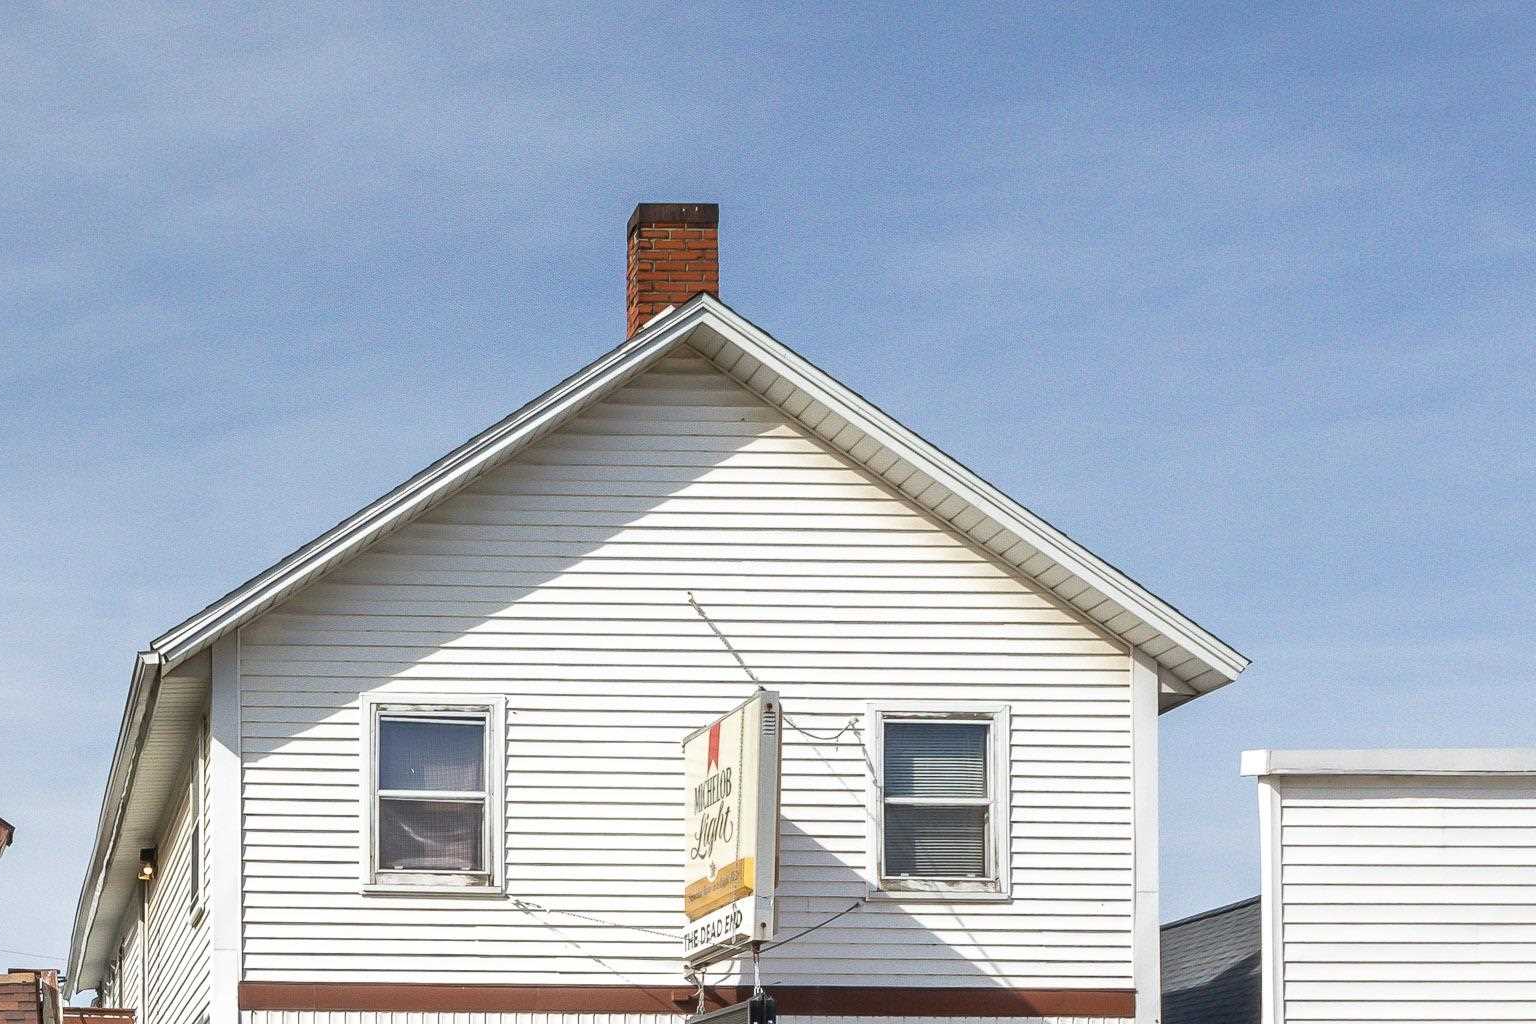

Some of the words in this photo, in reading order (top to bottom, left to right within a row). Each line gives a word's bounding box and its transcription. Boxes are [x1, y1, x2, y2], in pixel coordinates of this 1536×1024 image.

[693, 766, 732, 815] MICHELOB
[690, 800, 733, 860] Light
[683, 929, 699, 952] THE
[701, 919, 722, 945] DEAD
[724, 909, 743, 934] END
